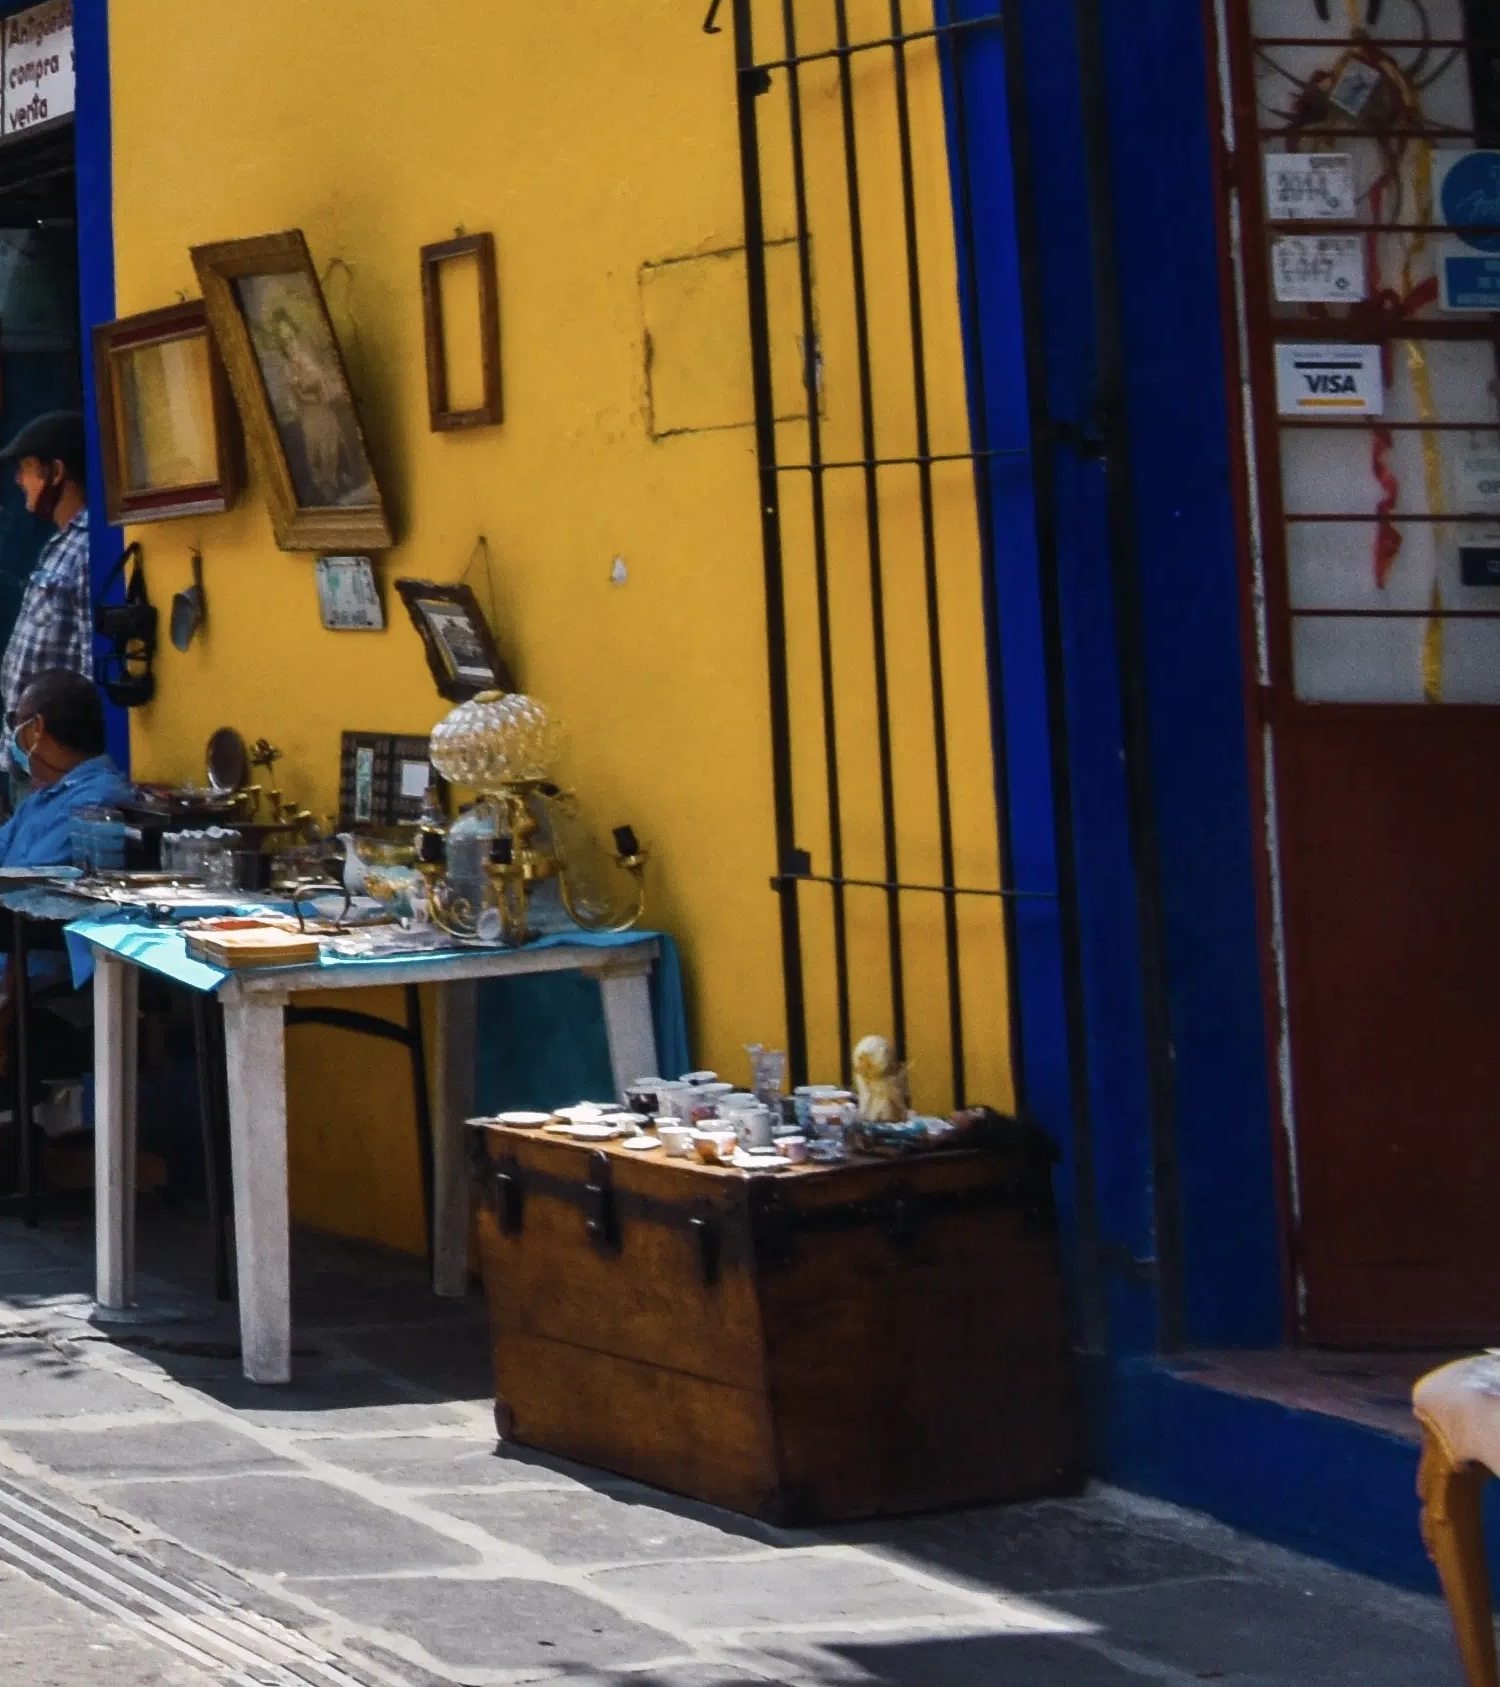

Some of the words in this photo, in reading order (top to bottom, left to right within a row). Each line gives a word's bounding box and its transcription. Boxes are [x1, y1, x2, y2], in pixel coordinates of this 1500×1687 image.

[9, 54, 60, 89] compra
[9, 92, 48, 130] venta
[1303, 374, 1357, 393] VISA
